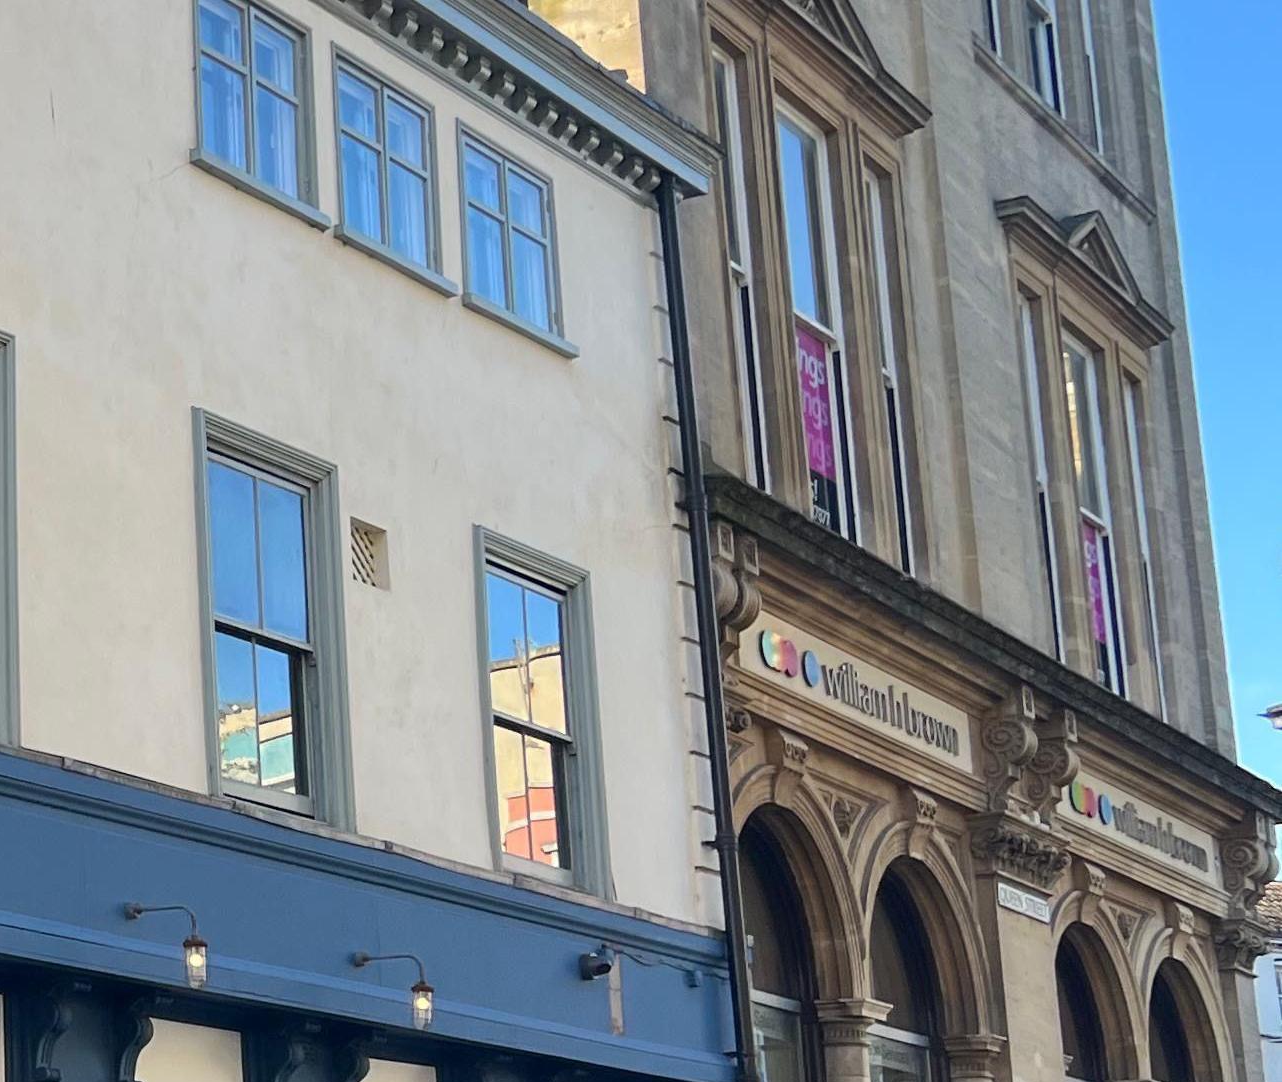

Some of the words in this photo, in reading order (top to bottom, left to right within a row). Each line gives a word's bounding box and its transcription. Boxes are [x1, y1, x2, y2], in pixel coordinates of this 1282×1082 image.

[820, 662, 888, 723] william
[888, 684, 903, 729] h
[902, 692, 960, 757] brown
[999, 885, 1024, 909] QUEEN
